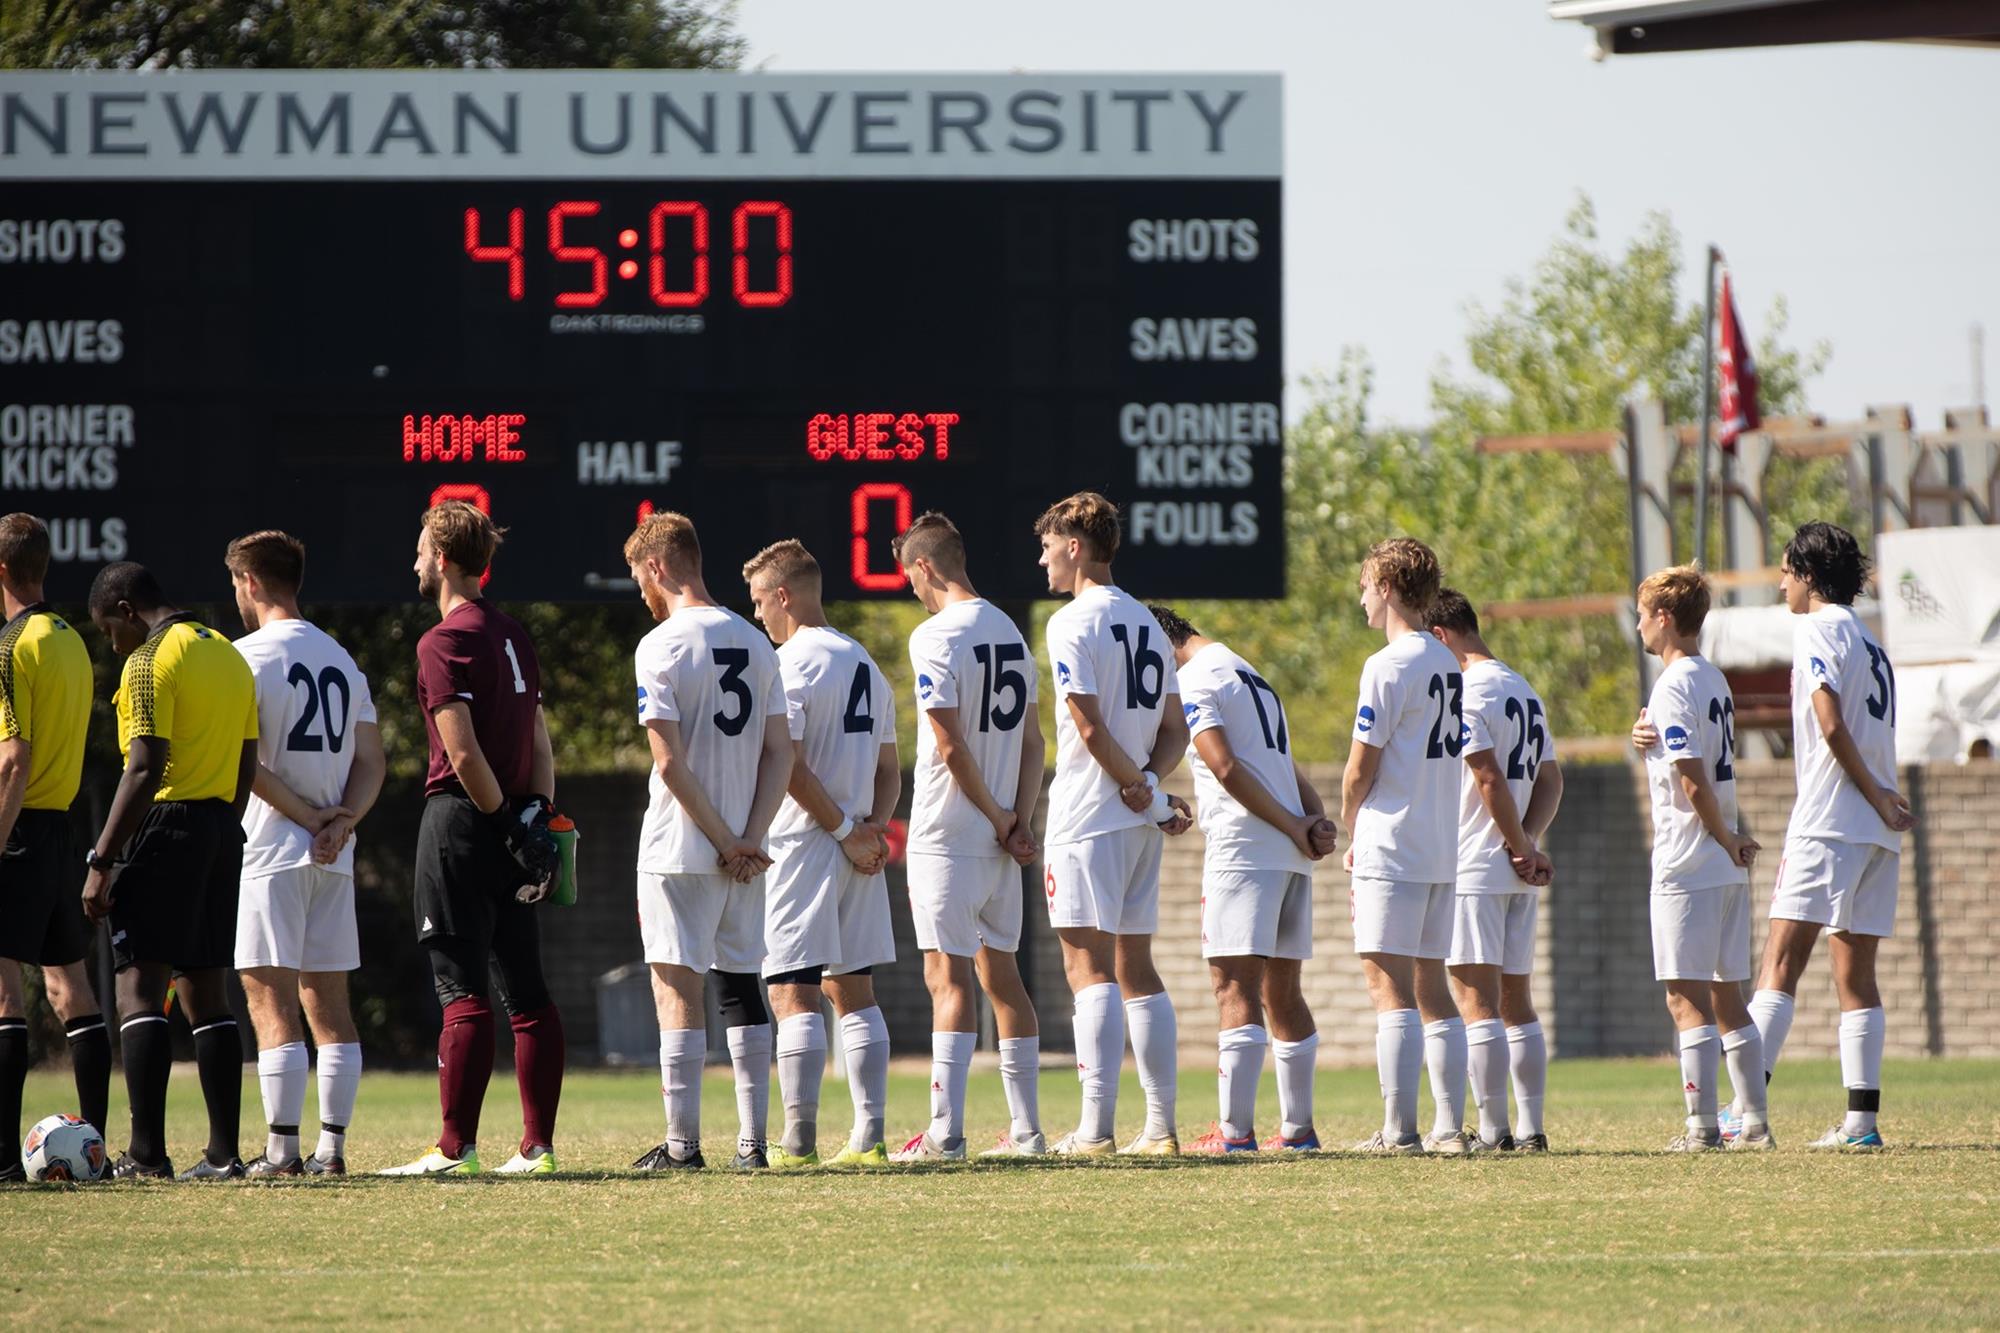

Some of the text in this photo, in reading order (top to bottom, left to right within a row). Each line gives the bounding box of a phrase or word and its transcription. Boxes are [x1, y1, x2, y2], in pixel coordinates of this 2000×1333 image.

[2, 90, 1247, 157] NEWMAN UNIVERSITY
[0, 219, 125, 262] SHOTS
[464, 201, 794, 308] 45:00
[1128, 218, 1259, 262] SHOTS
[0, 320, 124, 363] SAVES
[550, 314, 704, 334] DAKTRONICS
[1130, 317, 1258, 361] SAVES
[0, 404, 136, 447] ORNER
[403, 414, 526, 462] HOME
[807, 413, 960, 461] GUEST
[1119, 403, 1280, 447] CORNER
[1, 446, 119, 490] KICKS
[577, 441, 681, 484] HALF
[1136, 444, 1253, 487] KICKS
[40, 517, 128, 562] ULS
[851, 483, 913, 591] 0
[1130, 502, 1259, 546] FOULS
[505, 638, 526, 693] 1
[972, 643, 1027, 733] 15
[1110, 624, 1164, 710] 16
[287, 662, 351, 754] 20
[712, 648, 753, 737] 3
[843, 661, 875, 735] 4
[1235, 669, 1287, 755] 17
[1426, 672, 1463, 760] 23
[1505, 696, 1545, 782] 25
